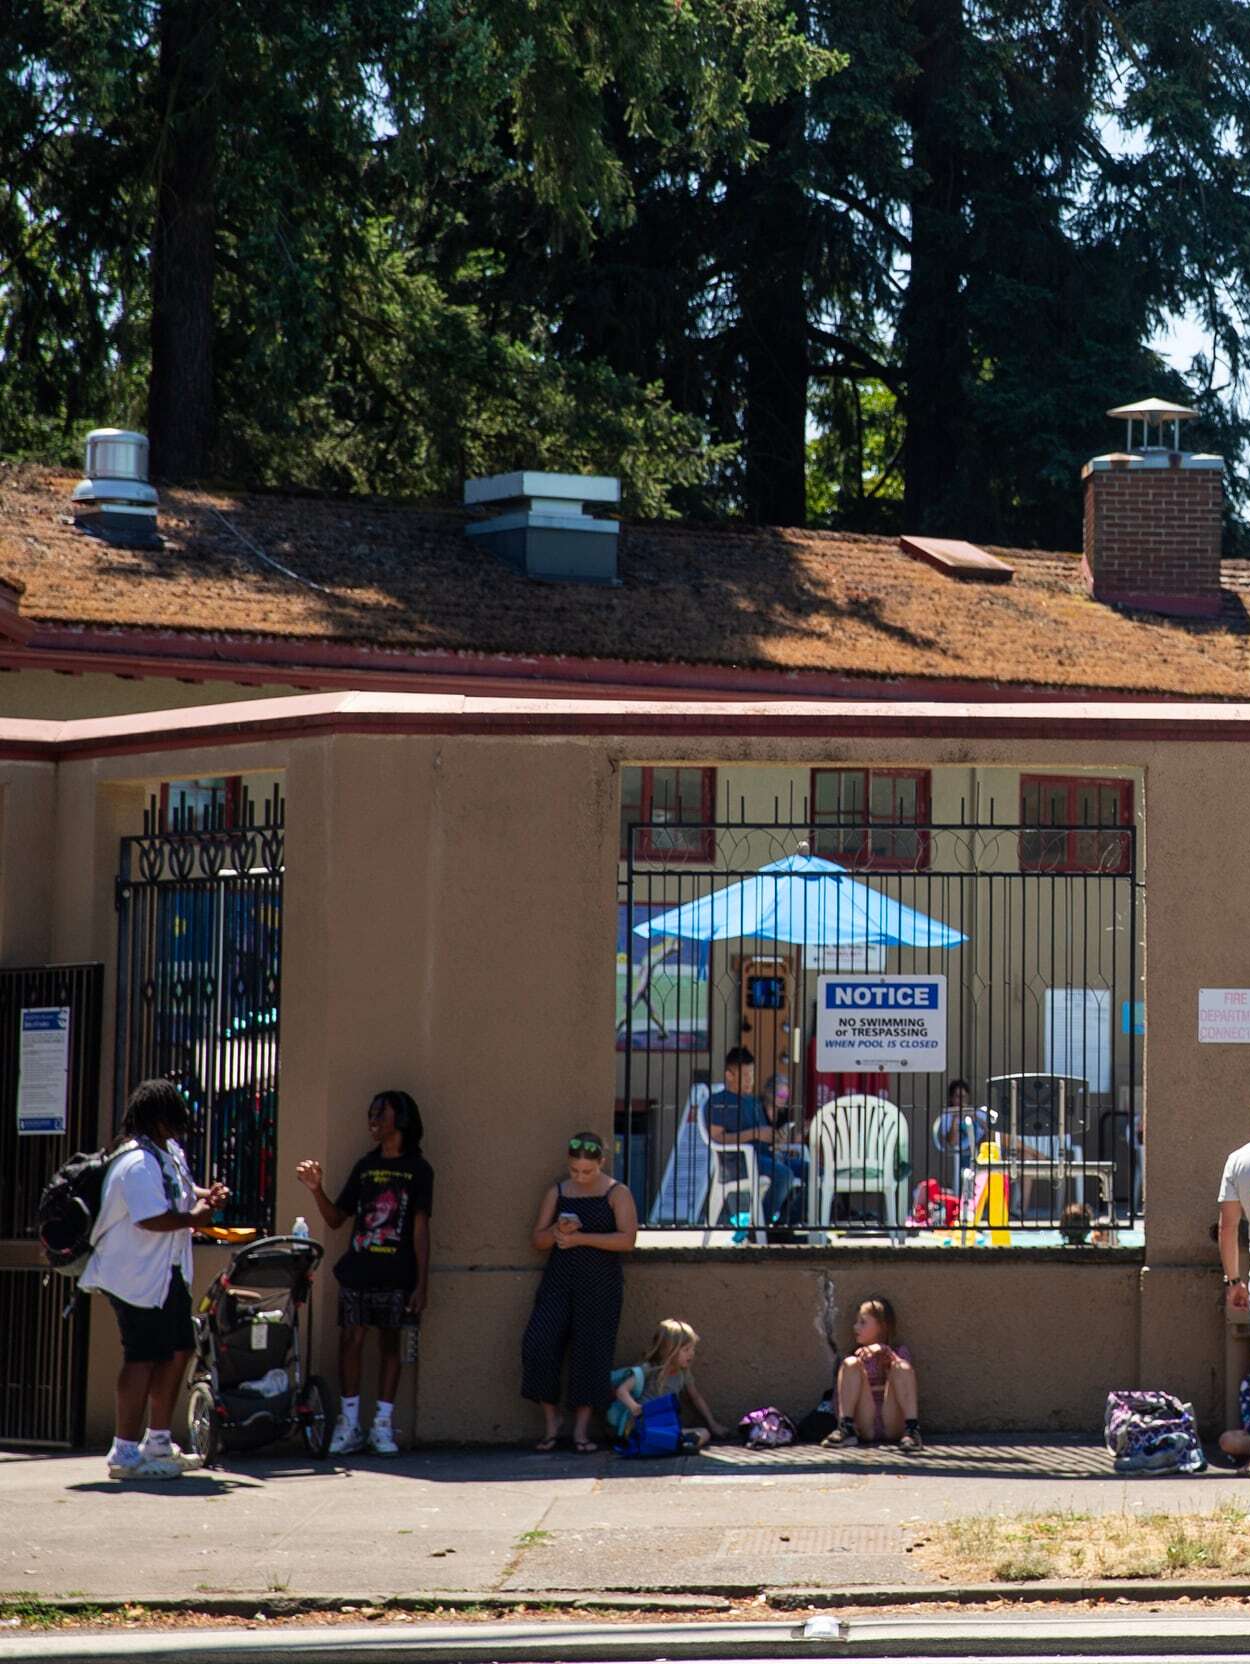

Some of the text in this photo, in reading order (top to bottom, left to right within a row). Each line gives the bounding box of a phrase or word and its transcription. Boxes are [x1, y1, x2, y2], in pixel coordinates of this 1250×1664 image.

[835, 986, 930, 1006] NOTICE
[1224, 992, 1248, 1005] FIRE
[839, 1018, 925, 1027] NO SWIMMING
[852, 1028, 928, 1037] TRESPASSING
[825, 1040, 938, 1048] WHEN POOL IS CLOSED
